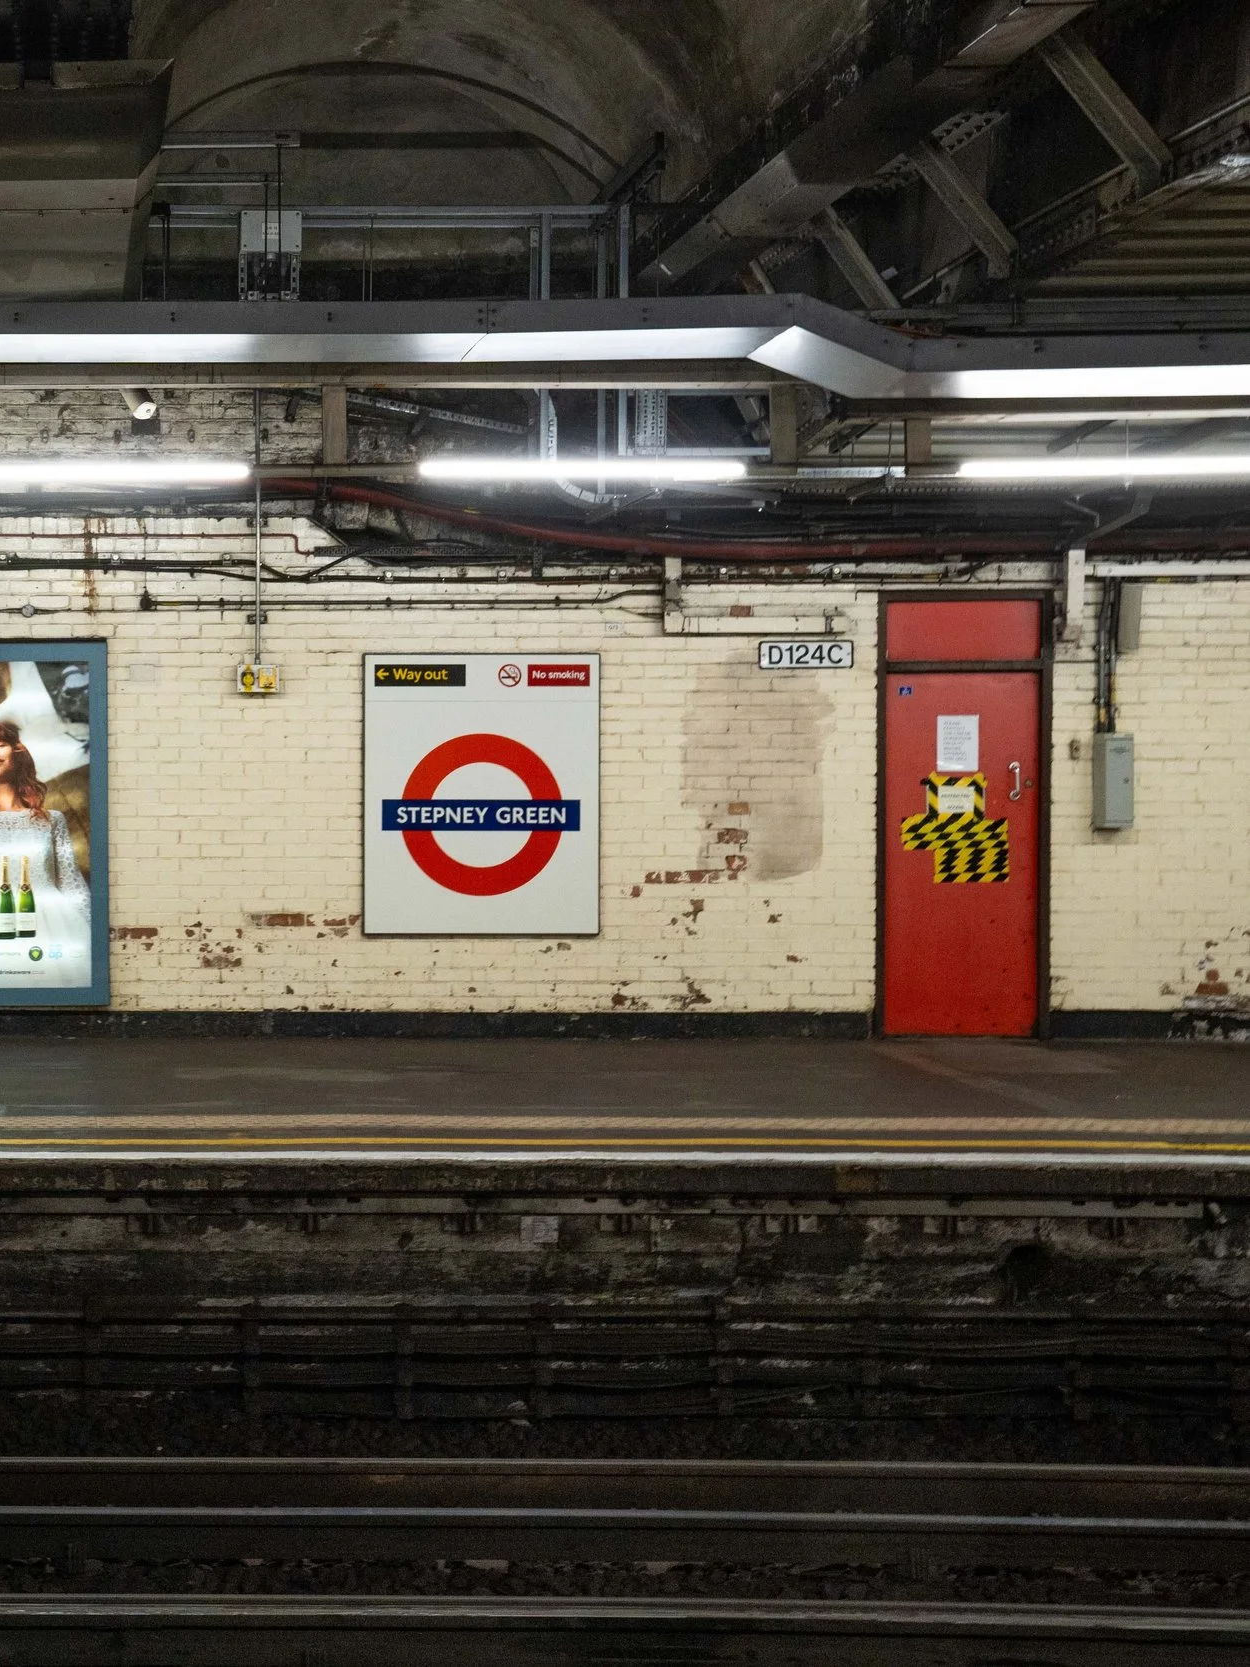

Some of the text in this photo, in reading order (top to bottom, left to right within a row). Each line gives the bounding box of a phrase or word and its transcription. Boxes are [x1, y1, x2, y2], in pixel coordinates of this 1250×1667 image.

[768, 644, 843, 664] D124C
[392, 668, 449, 683] Way out
[532, 670, 586, 681] No smoking
[396, 806, 567, 824] STEPNEY GREEN
